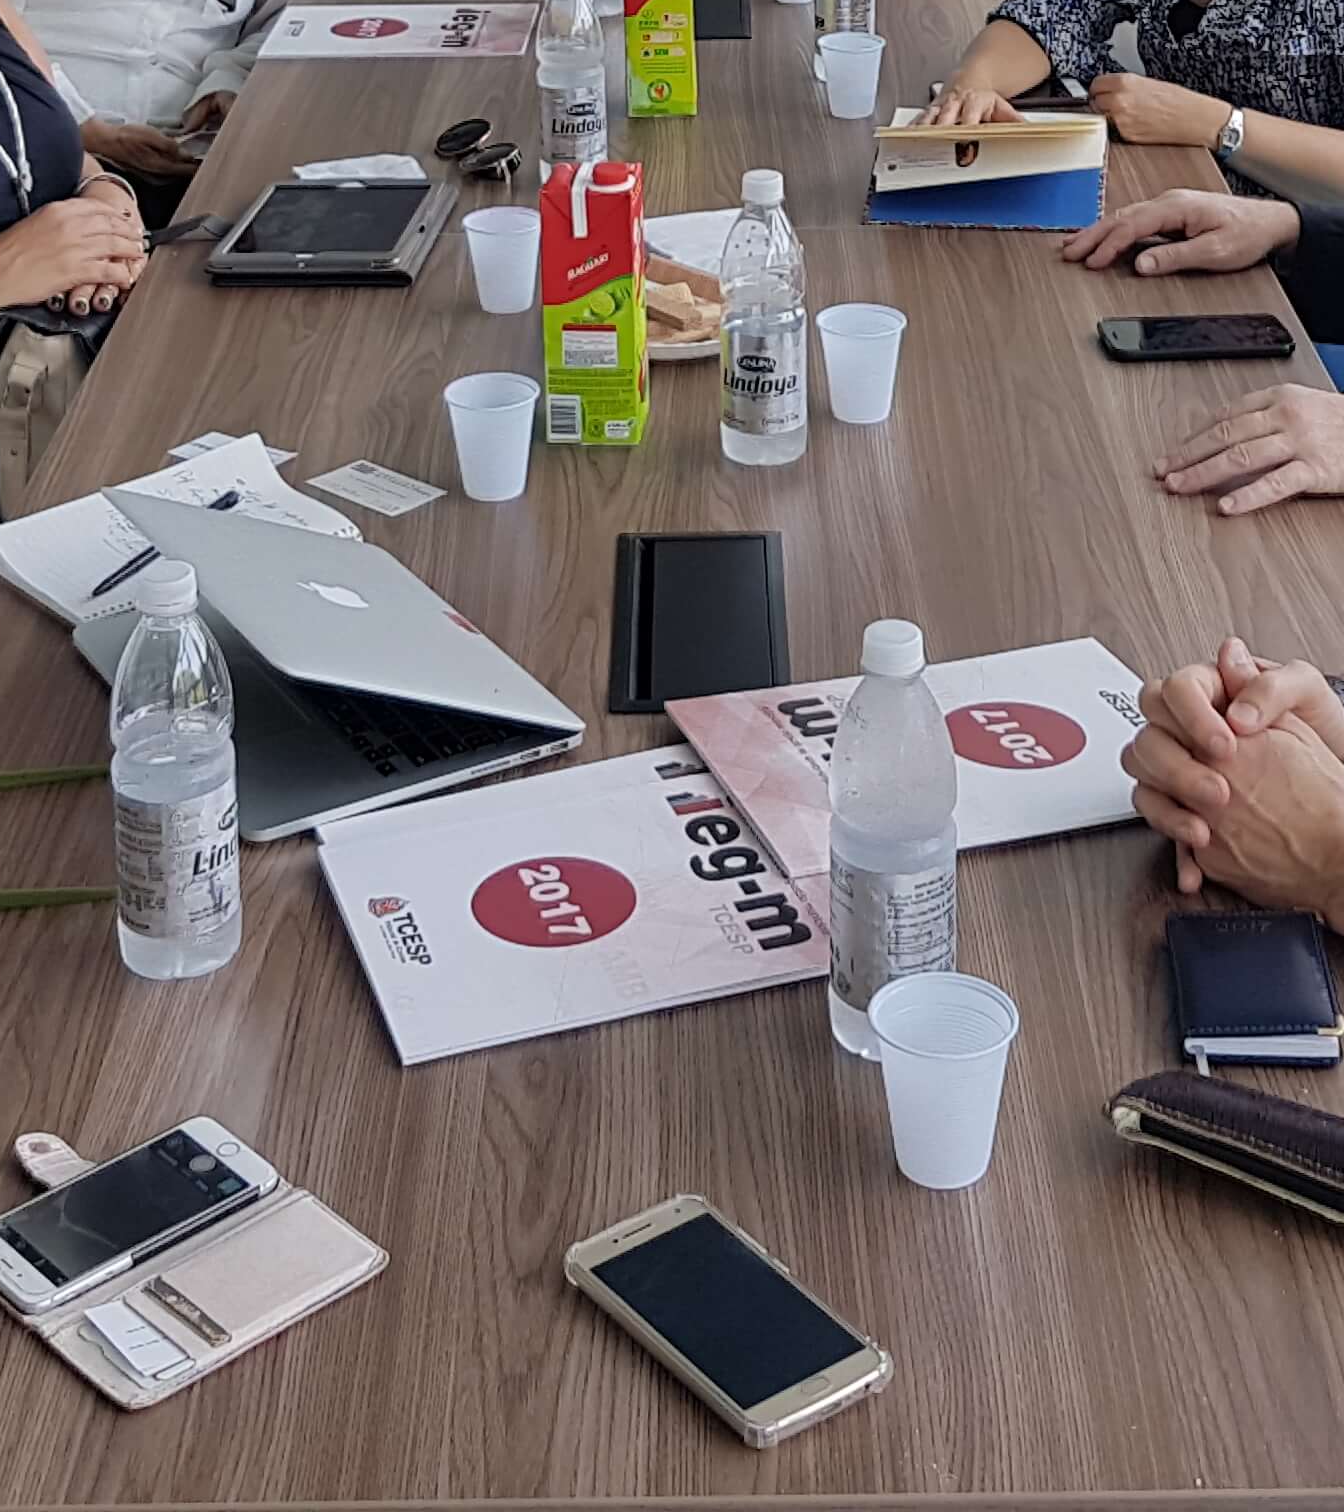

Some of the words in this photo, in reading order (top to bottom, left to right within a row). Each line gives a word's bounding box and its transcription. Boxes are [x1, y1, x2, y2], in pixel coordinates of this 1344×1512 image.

[551, 118, 602, 135] Lindoy
[723, 367, 798, 397] Lindoya
[968, 708, 1054, 765] 2017
[517, 863, 593, 937] 2017
[392, 912, 432, 966] TCESP
[708, 903, 755, 956] TCESP
